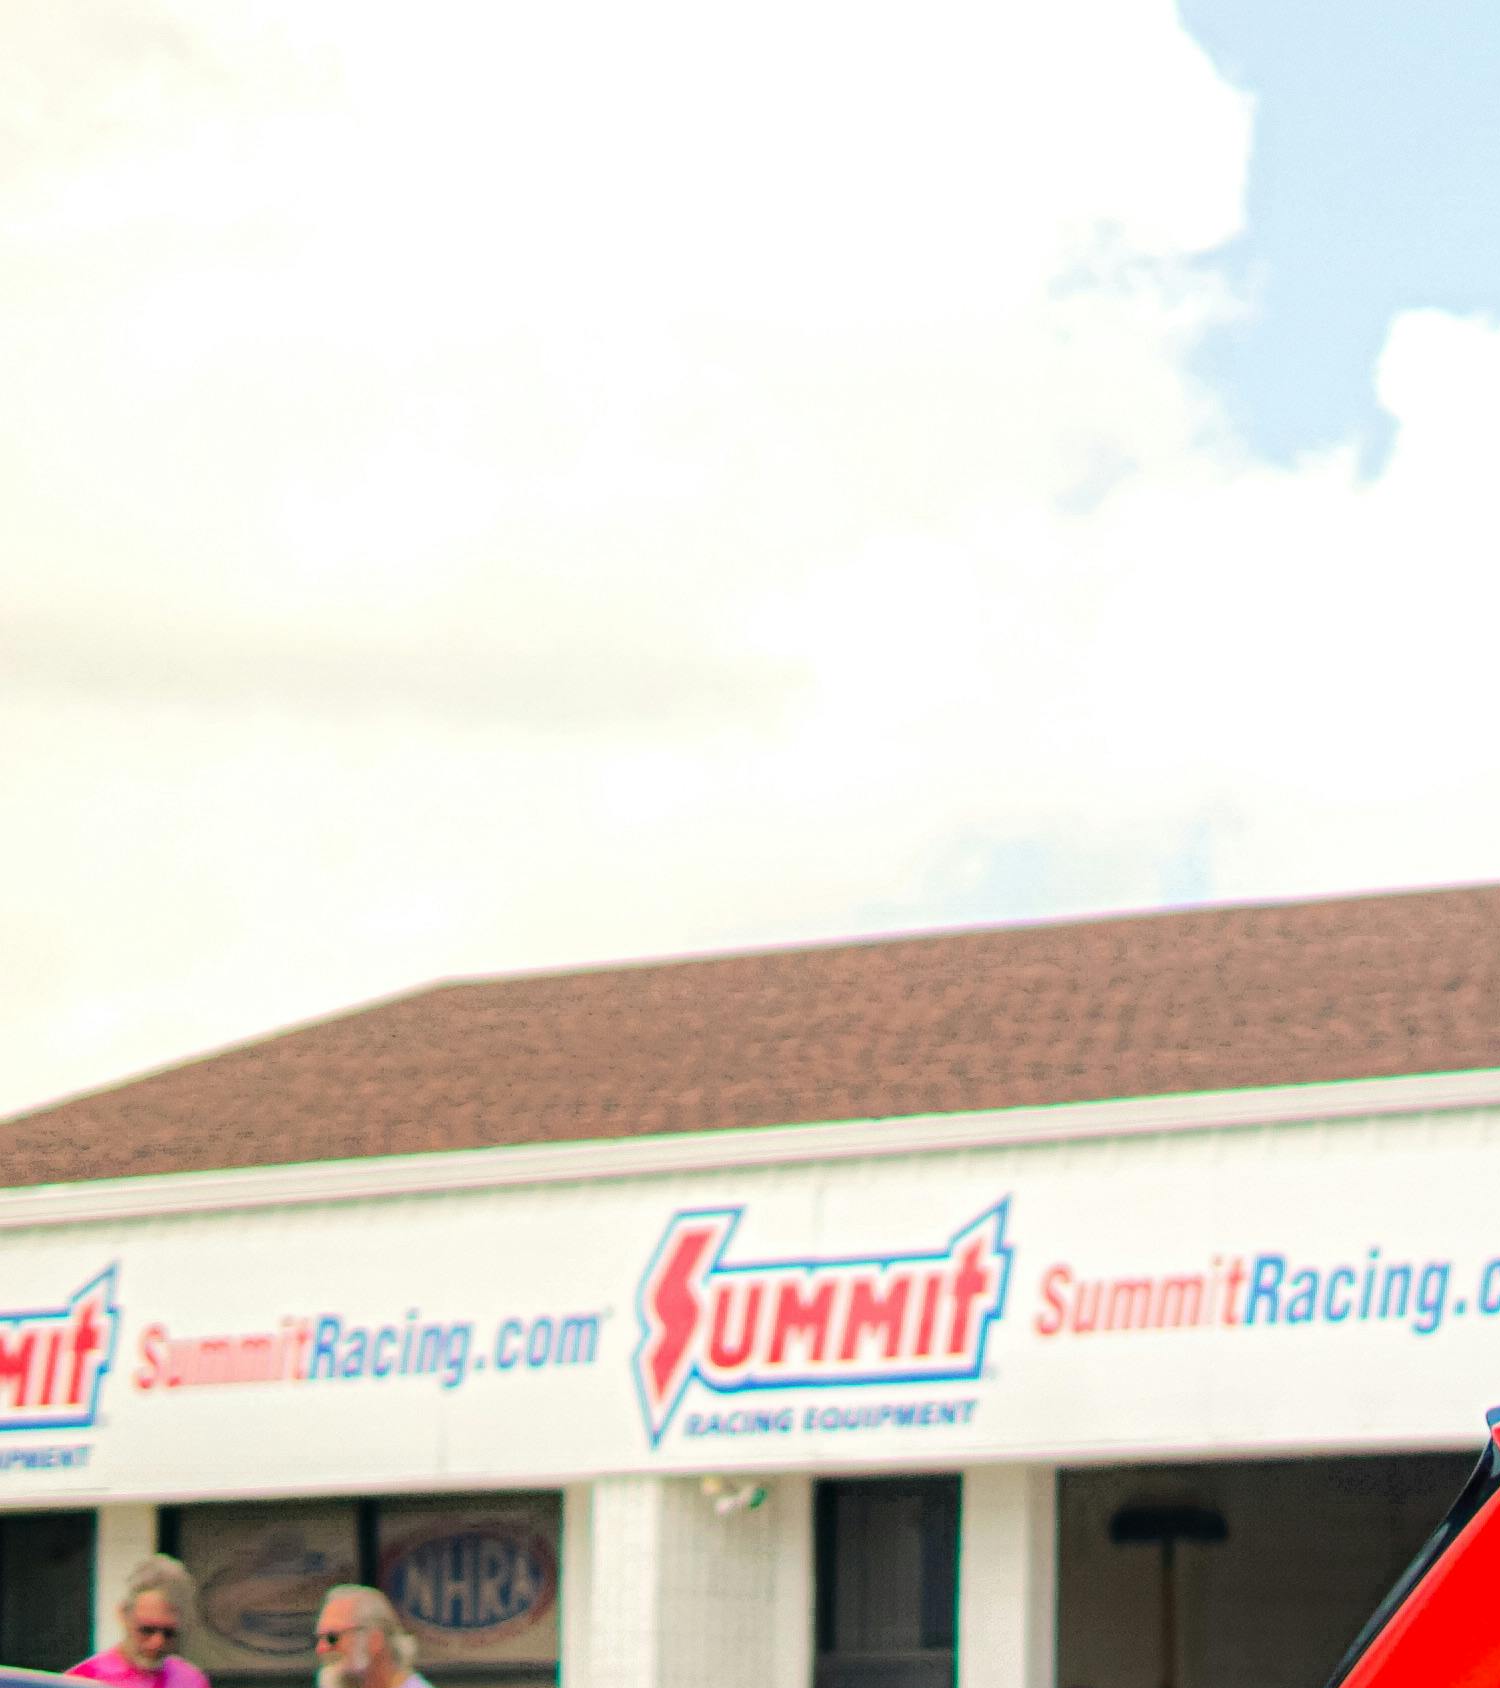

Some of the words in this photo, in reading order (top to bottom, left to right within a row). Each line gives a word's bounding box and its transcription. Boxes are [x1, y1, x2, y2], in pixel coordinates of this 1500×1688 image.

[684, 1408, 793, 1438] RACING
[802, 1398, 978, 1434] EQUIPMENT
[402, 1540, 537, 1625] NHRA
